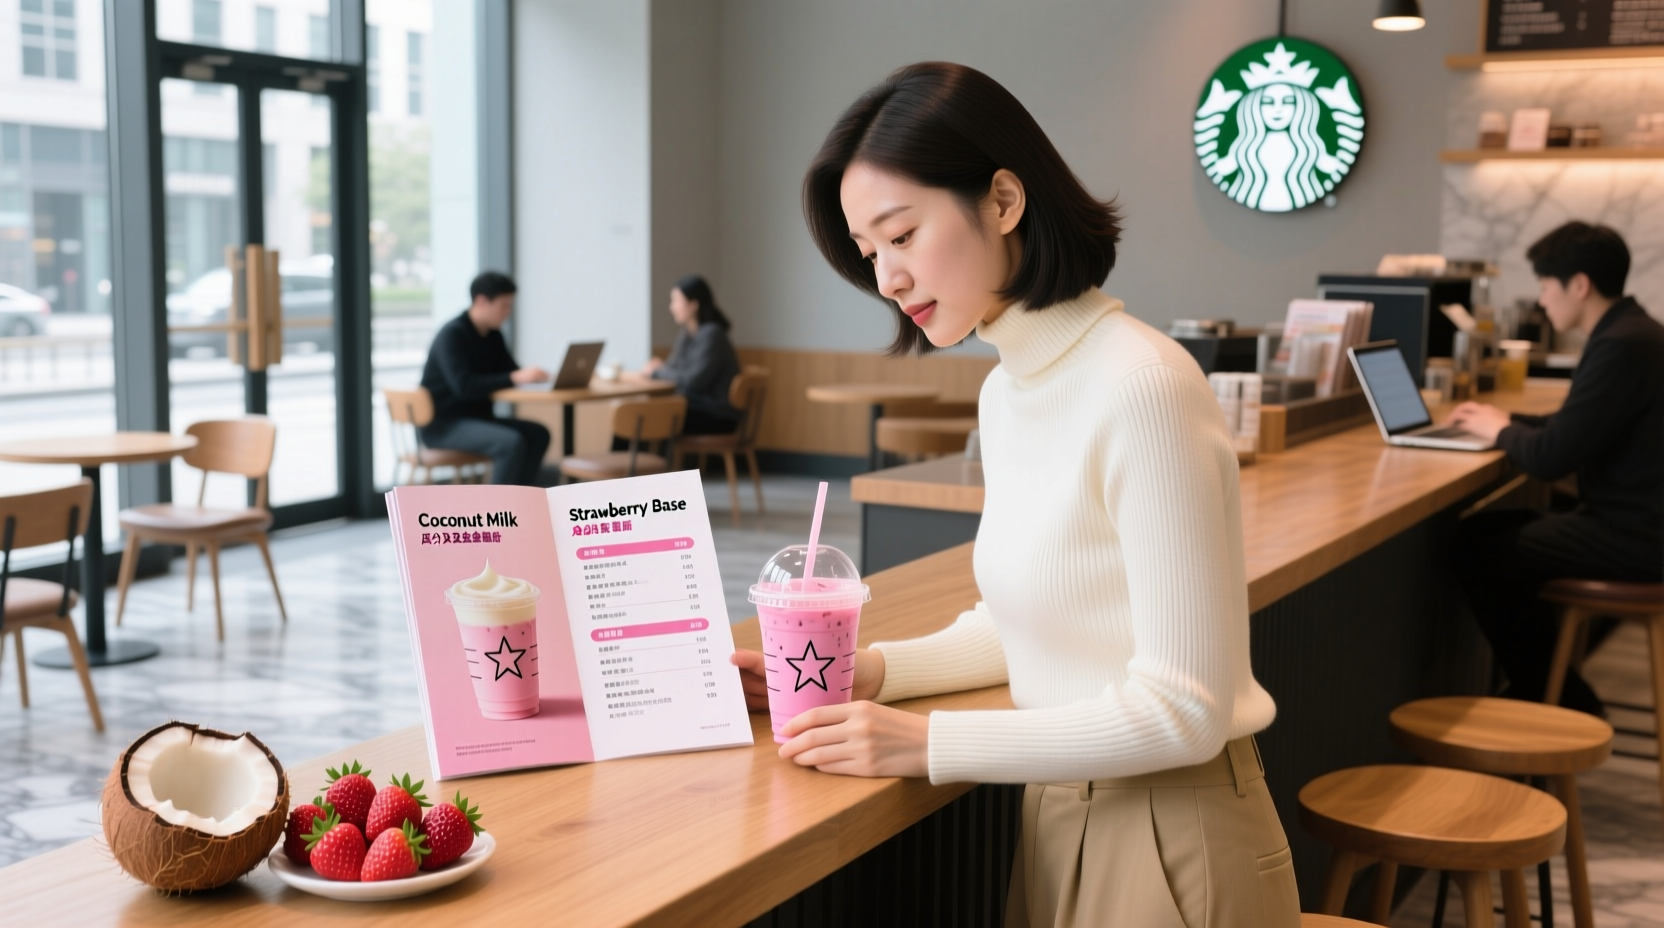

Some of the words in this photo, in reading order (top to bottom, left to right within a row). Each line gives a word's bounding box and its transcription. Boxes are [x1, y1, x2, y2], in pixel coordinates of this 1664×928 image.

[418, 513, 484, 528] Coconut
[486, 511, 518, 528] Milk
[569, 502, 648, 522] Strawberry
[652, 499, 687, 513] Base
